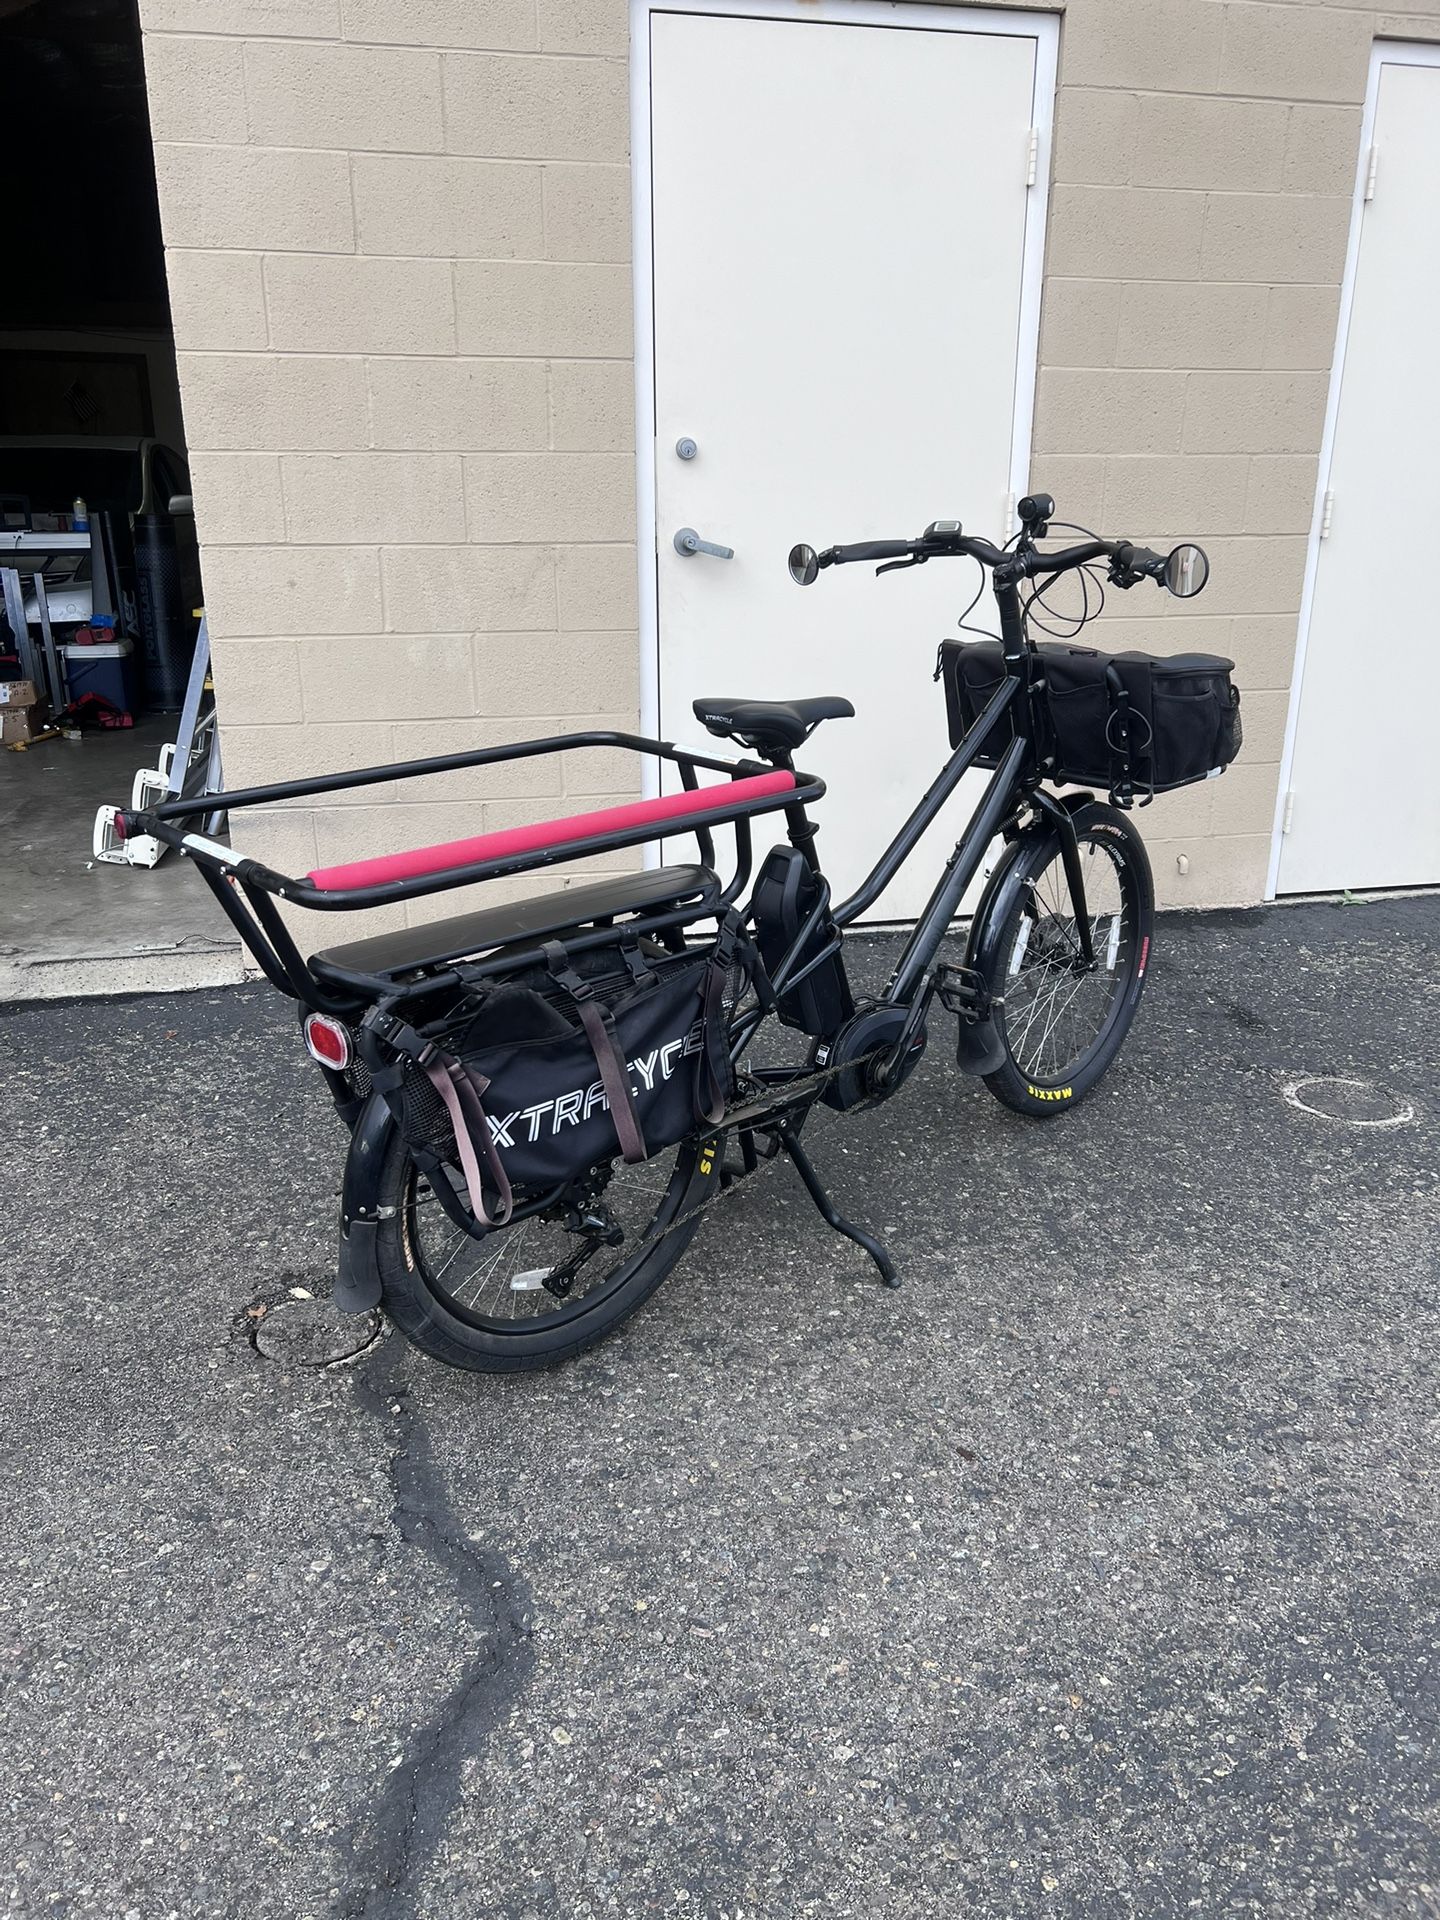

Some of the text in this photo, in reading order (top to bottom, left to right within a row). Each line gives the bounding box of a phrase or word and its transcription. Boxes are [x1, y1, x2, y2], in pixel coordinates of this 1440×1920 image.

[139, 576, 158, 661] POLYGLASS
[705, 714, 733, 725] XTRACYCLE
[1028, 1085, 1073, 1101] MAXXIS
